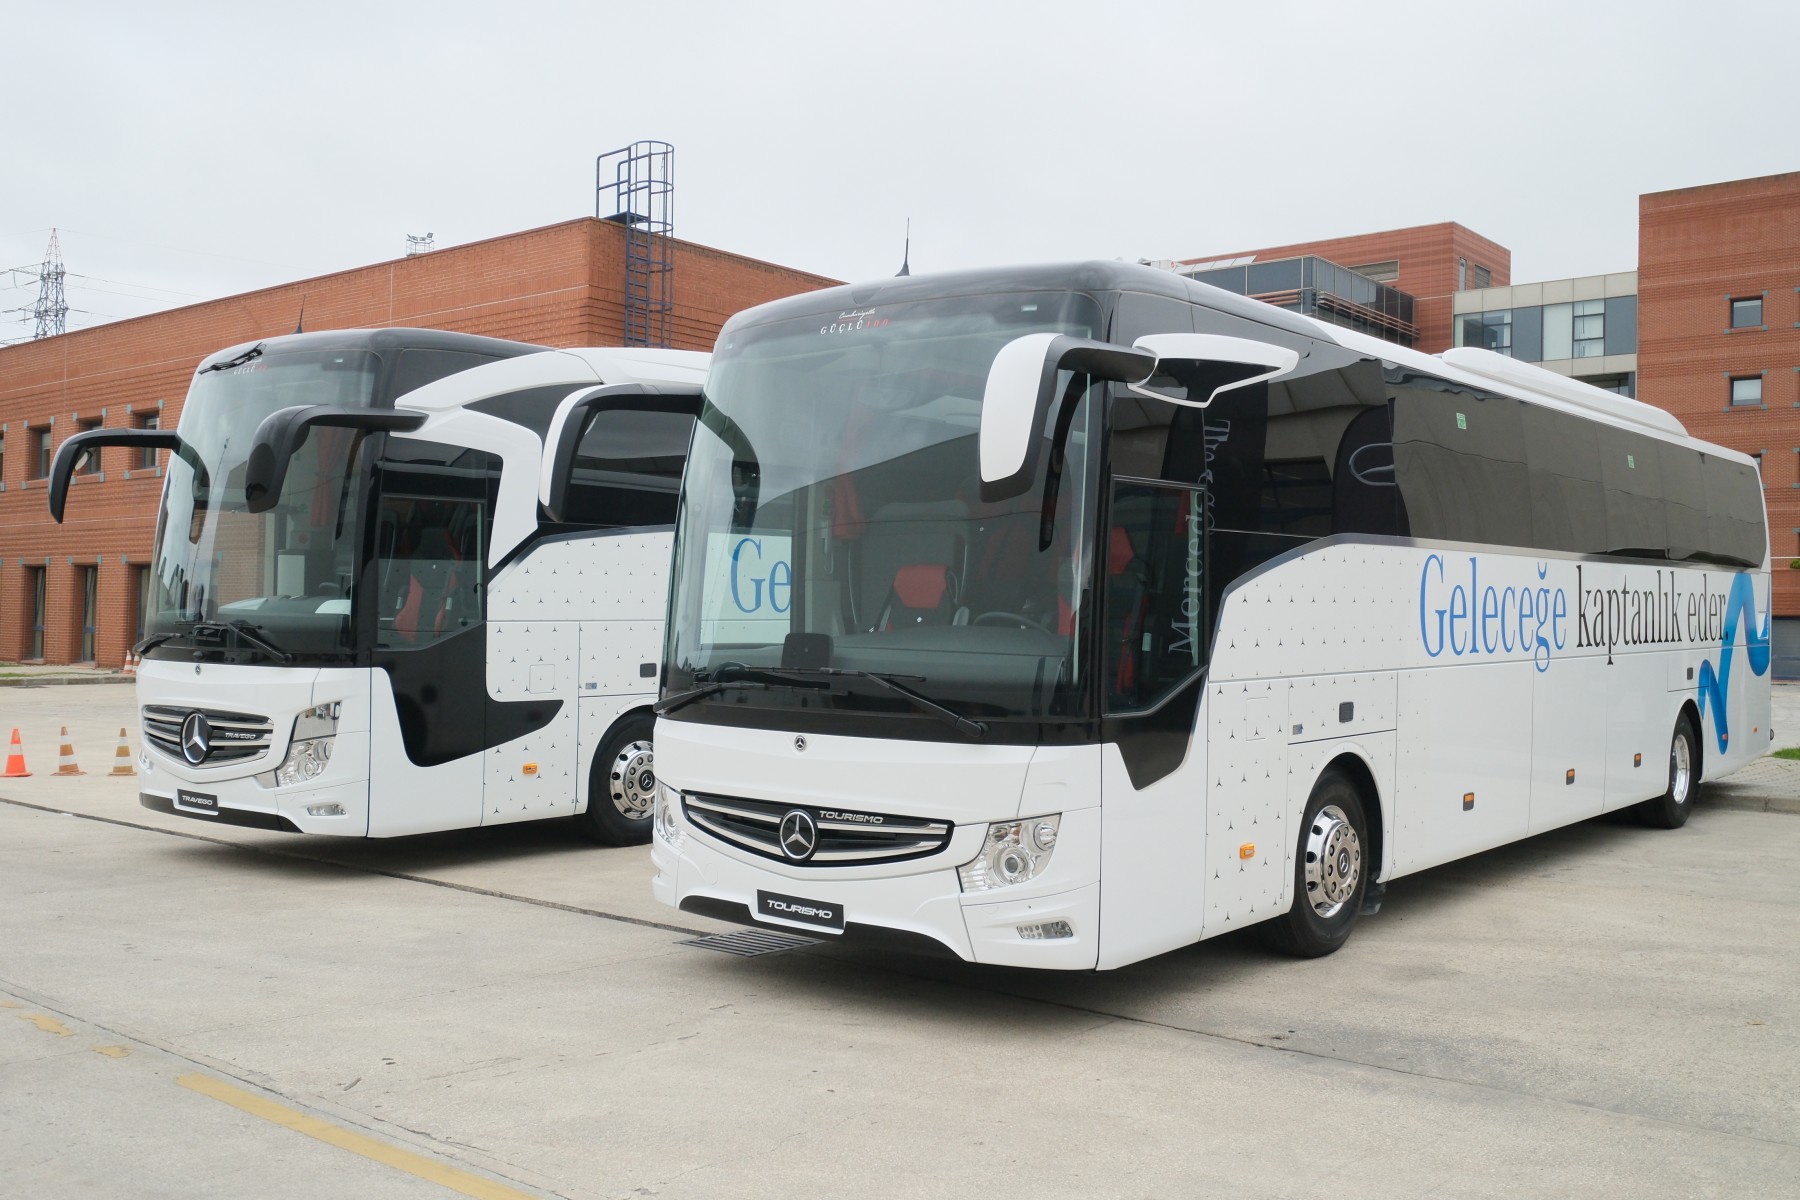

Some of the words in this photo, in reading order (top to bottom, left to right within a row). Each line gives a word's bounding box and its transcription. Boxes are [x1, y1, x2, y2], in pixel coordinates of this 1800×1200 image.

[1420, 553, 1567, 673] Geleceğe
[1576, 564, 1682, 665] kaptanlık
[1687, 573, 1729, 643] eder.
[225, 732, 257, 740] TRAVEGO
[182, 795, 213, 806] TRAVEGO
[819, 810, 884, 824] TOURISMO
[767, 899, 833, 919] TOURISMO
